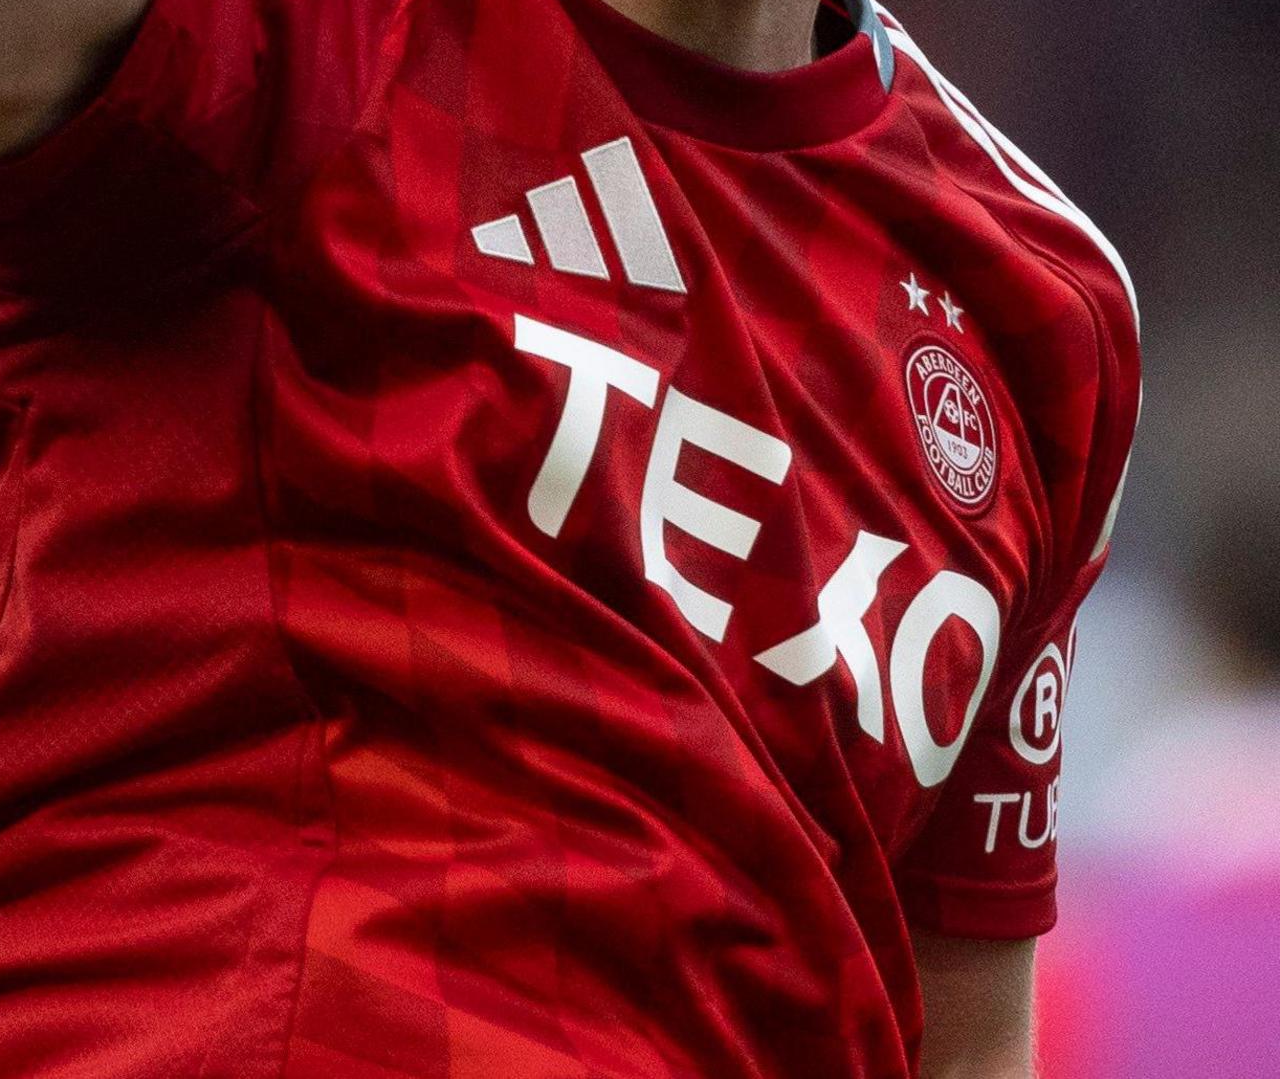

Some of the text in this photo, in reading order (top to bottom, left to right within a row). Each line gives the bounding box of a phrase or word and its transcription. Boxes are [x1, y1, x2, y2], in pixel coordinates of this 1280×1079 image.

[915, 352, 980, 405] ABERDEEN
[917, 414, 993, 496] FOOTBALL CLUB
[947, 440, 968, 460] 1903
[514, 313, 1001, 788] TEXO
